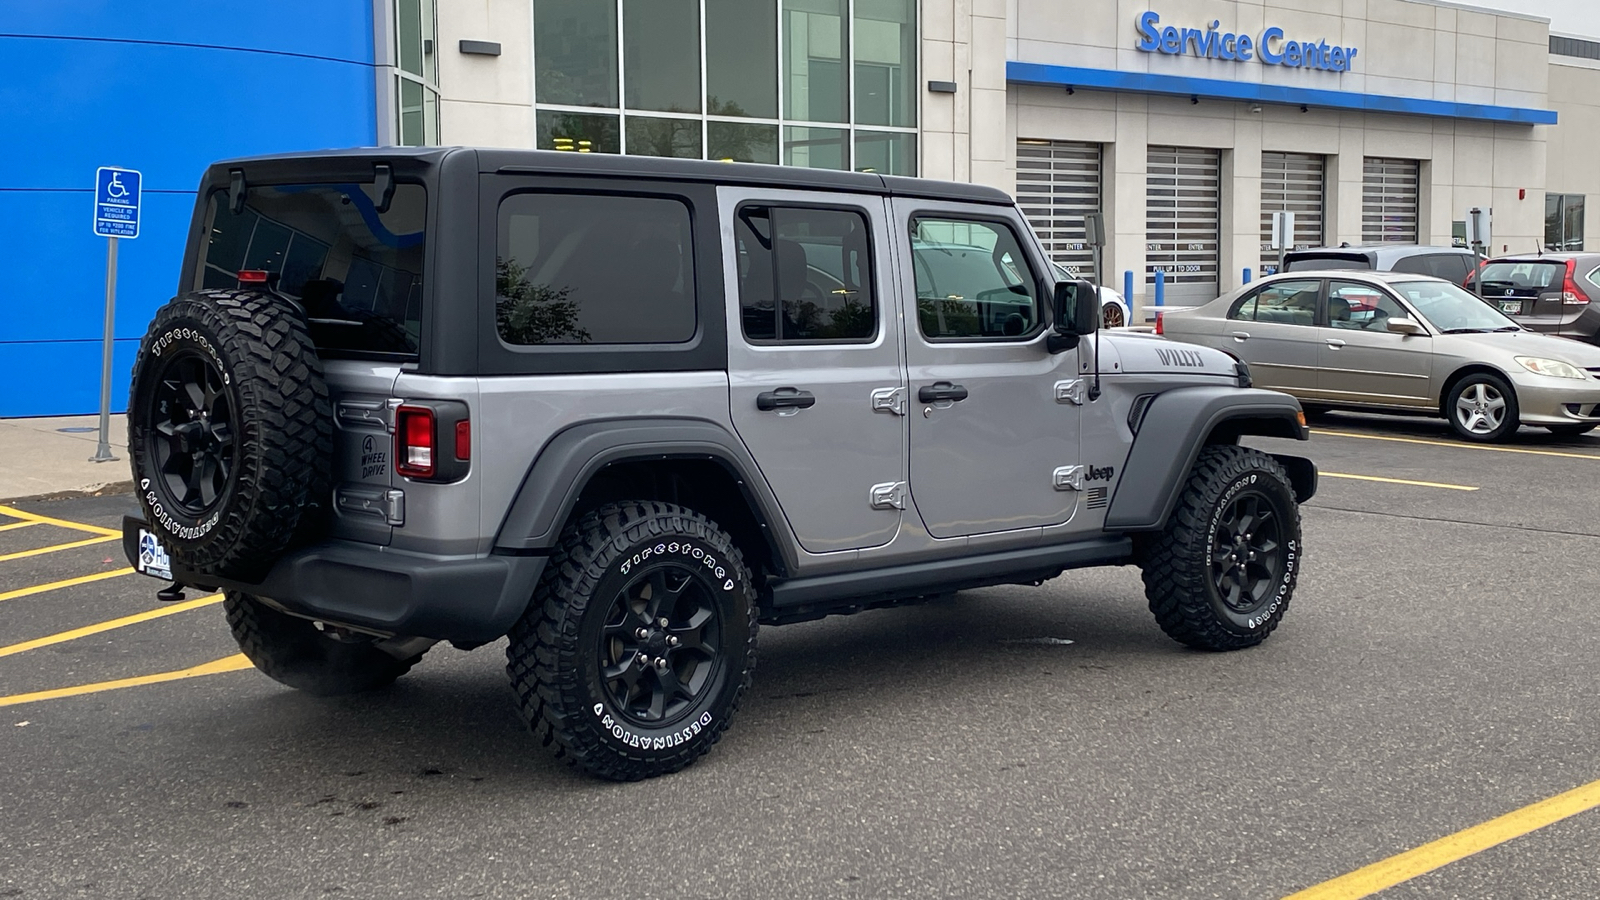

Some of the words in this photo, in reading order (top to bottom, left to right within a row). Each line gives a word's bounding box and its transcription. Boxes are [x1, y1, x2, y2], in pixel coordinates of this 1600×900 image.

[1135, 10, 1253, 62] Service
[1256, 26, 1358, 72] Center
[106, 197, 130, 205] PARKING
[103, 206, 124, 214] VEHICLE
[104, 212, 131, 220] REQUIRED
[1188, 243, 1204, 251] ENTER
[1154, 348, 1204, 367] WILLYS
[361, 452, 386, 467] WHEEL
[362, 464, 386, 479] DRIVE
[1084, 465, 1114, 482] Jeep
[146, 490, 220, 540] DESTINATION
[620, 542, 726, 580] Firestone
[602, 711, 713, 751] DESTINATION
